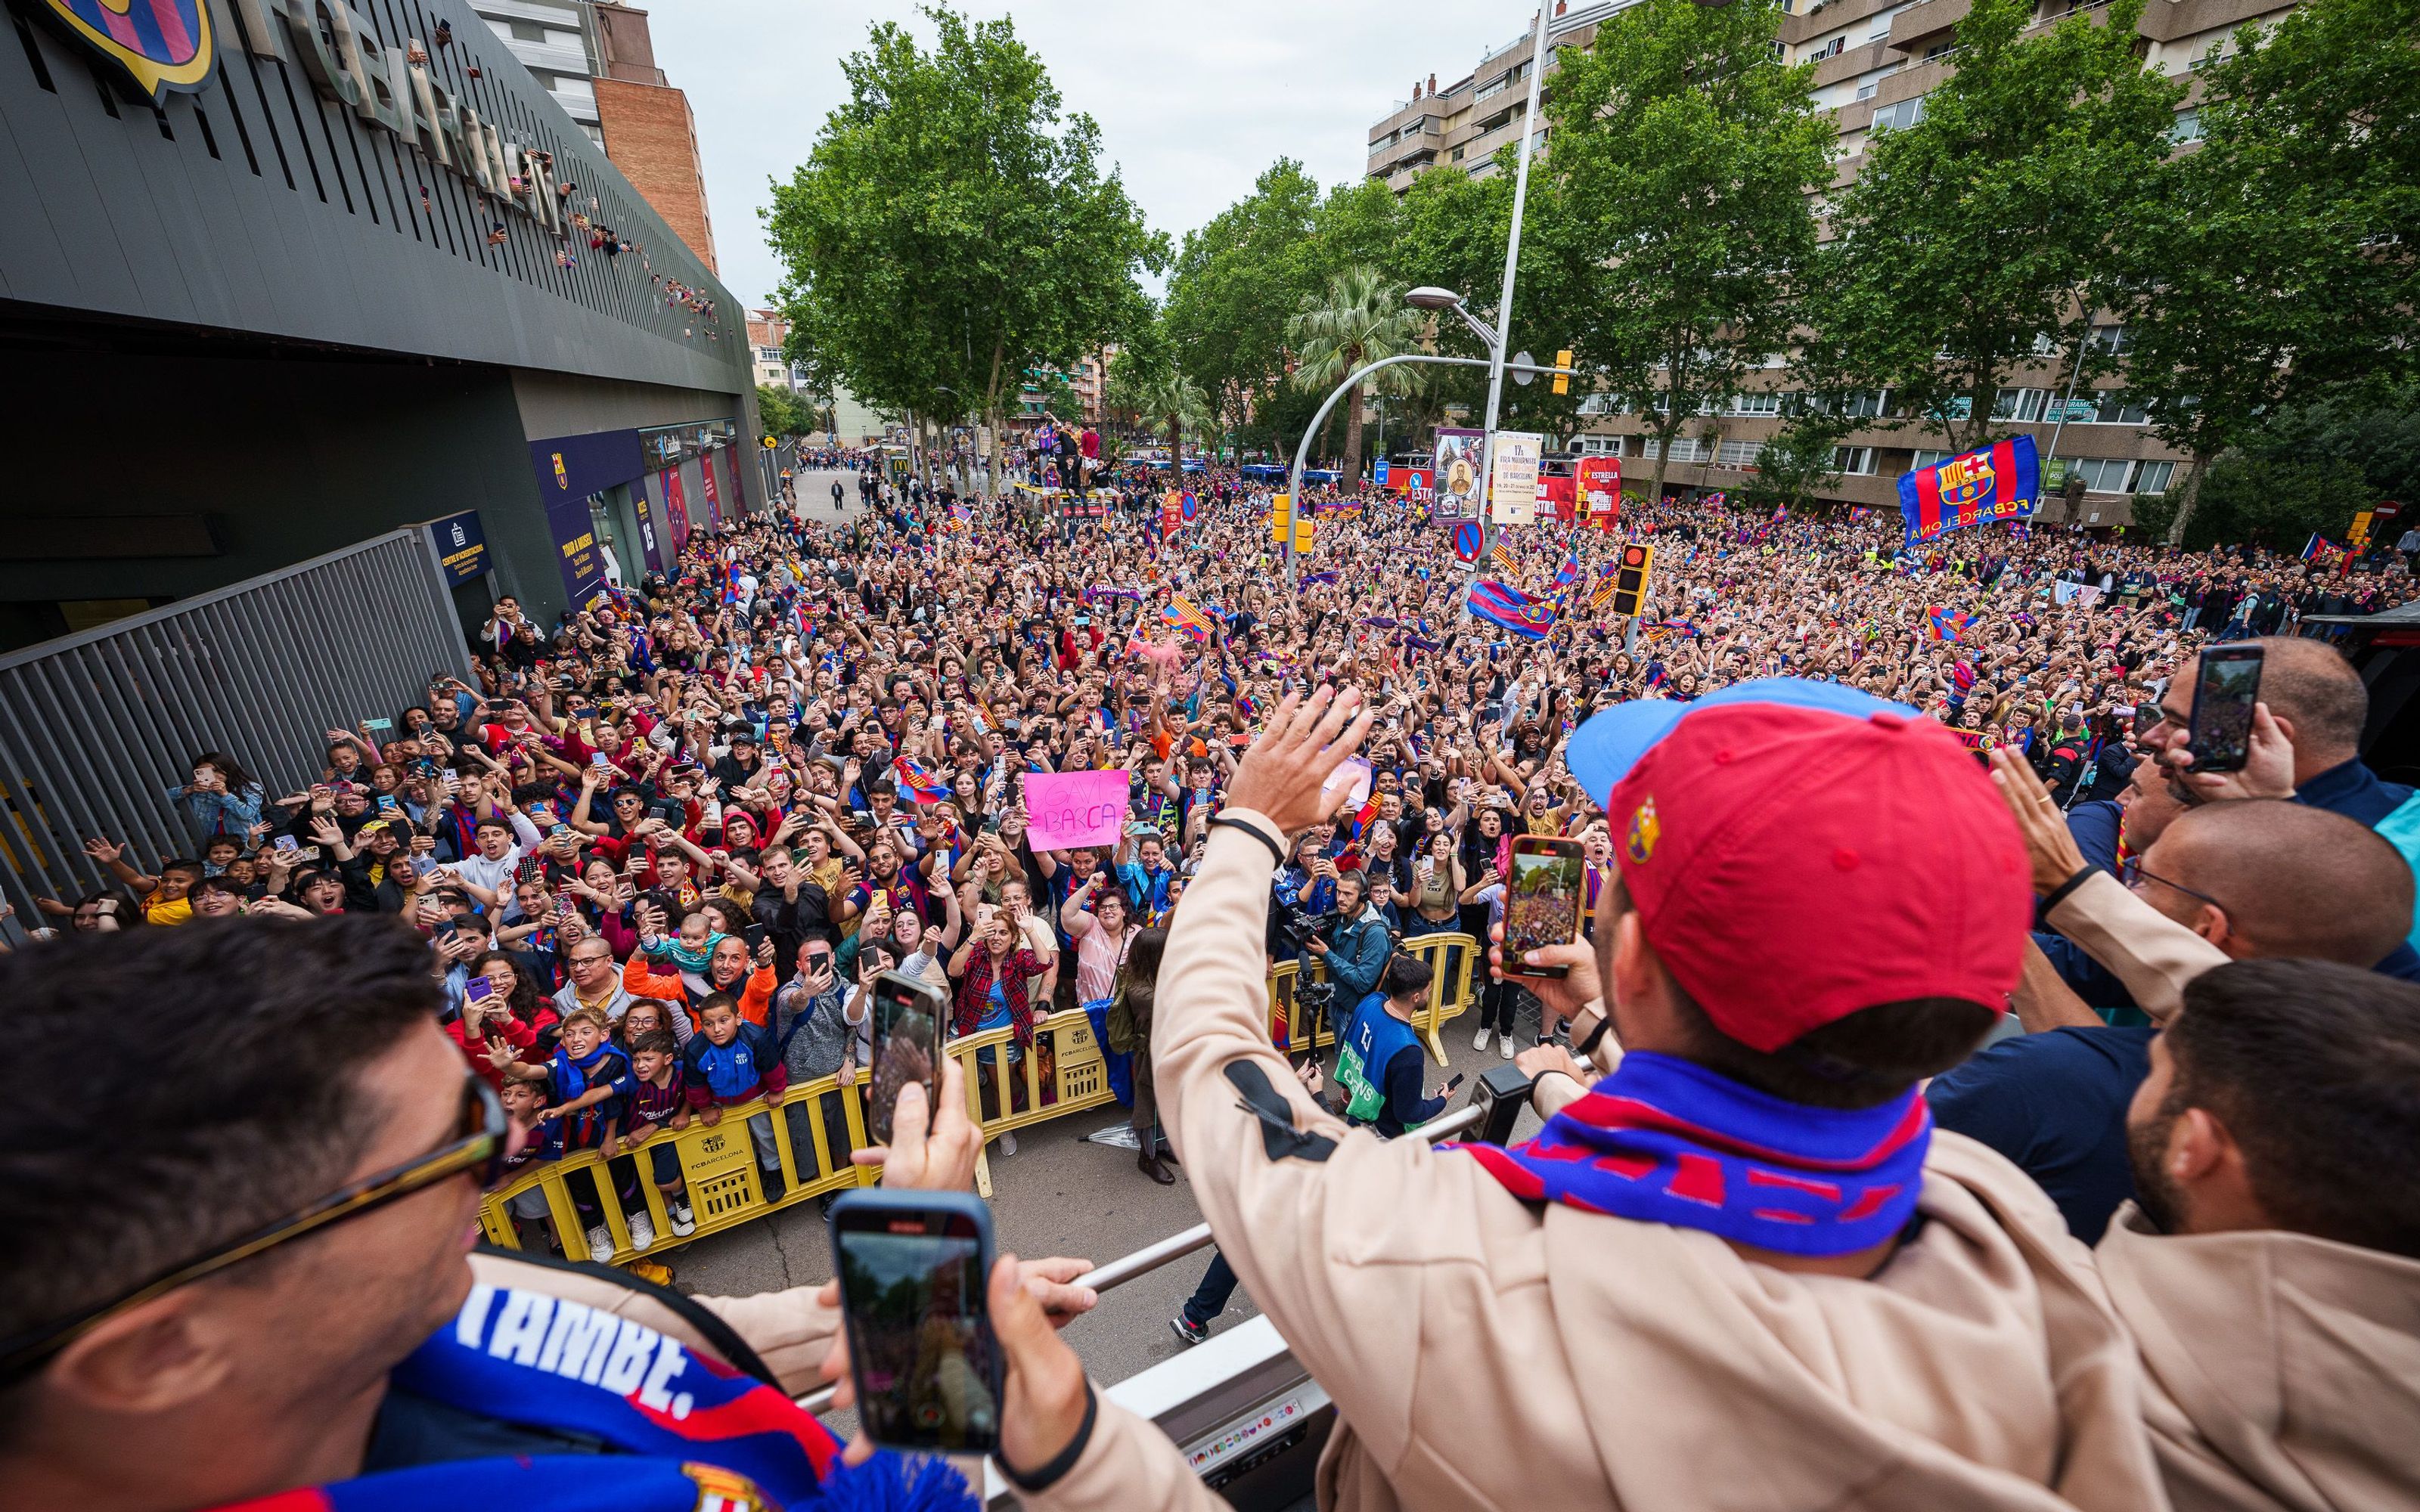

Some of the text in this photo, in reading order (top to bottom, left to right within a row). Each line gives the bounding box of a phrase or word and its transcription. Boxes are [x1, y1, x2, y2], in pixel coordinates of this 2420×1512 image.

[643, 522, 655, 552] 15
[1044, 803, 1117, 832] BARÇA
[690, 1149, 744, 1170] FCBARCELONA
